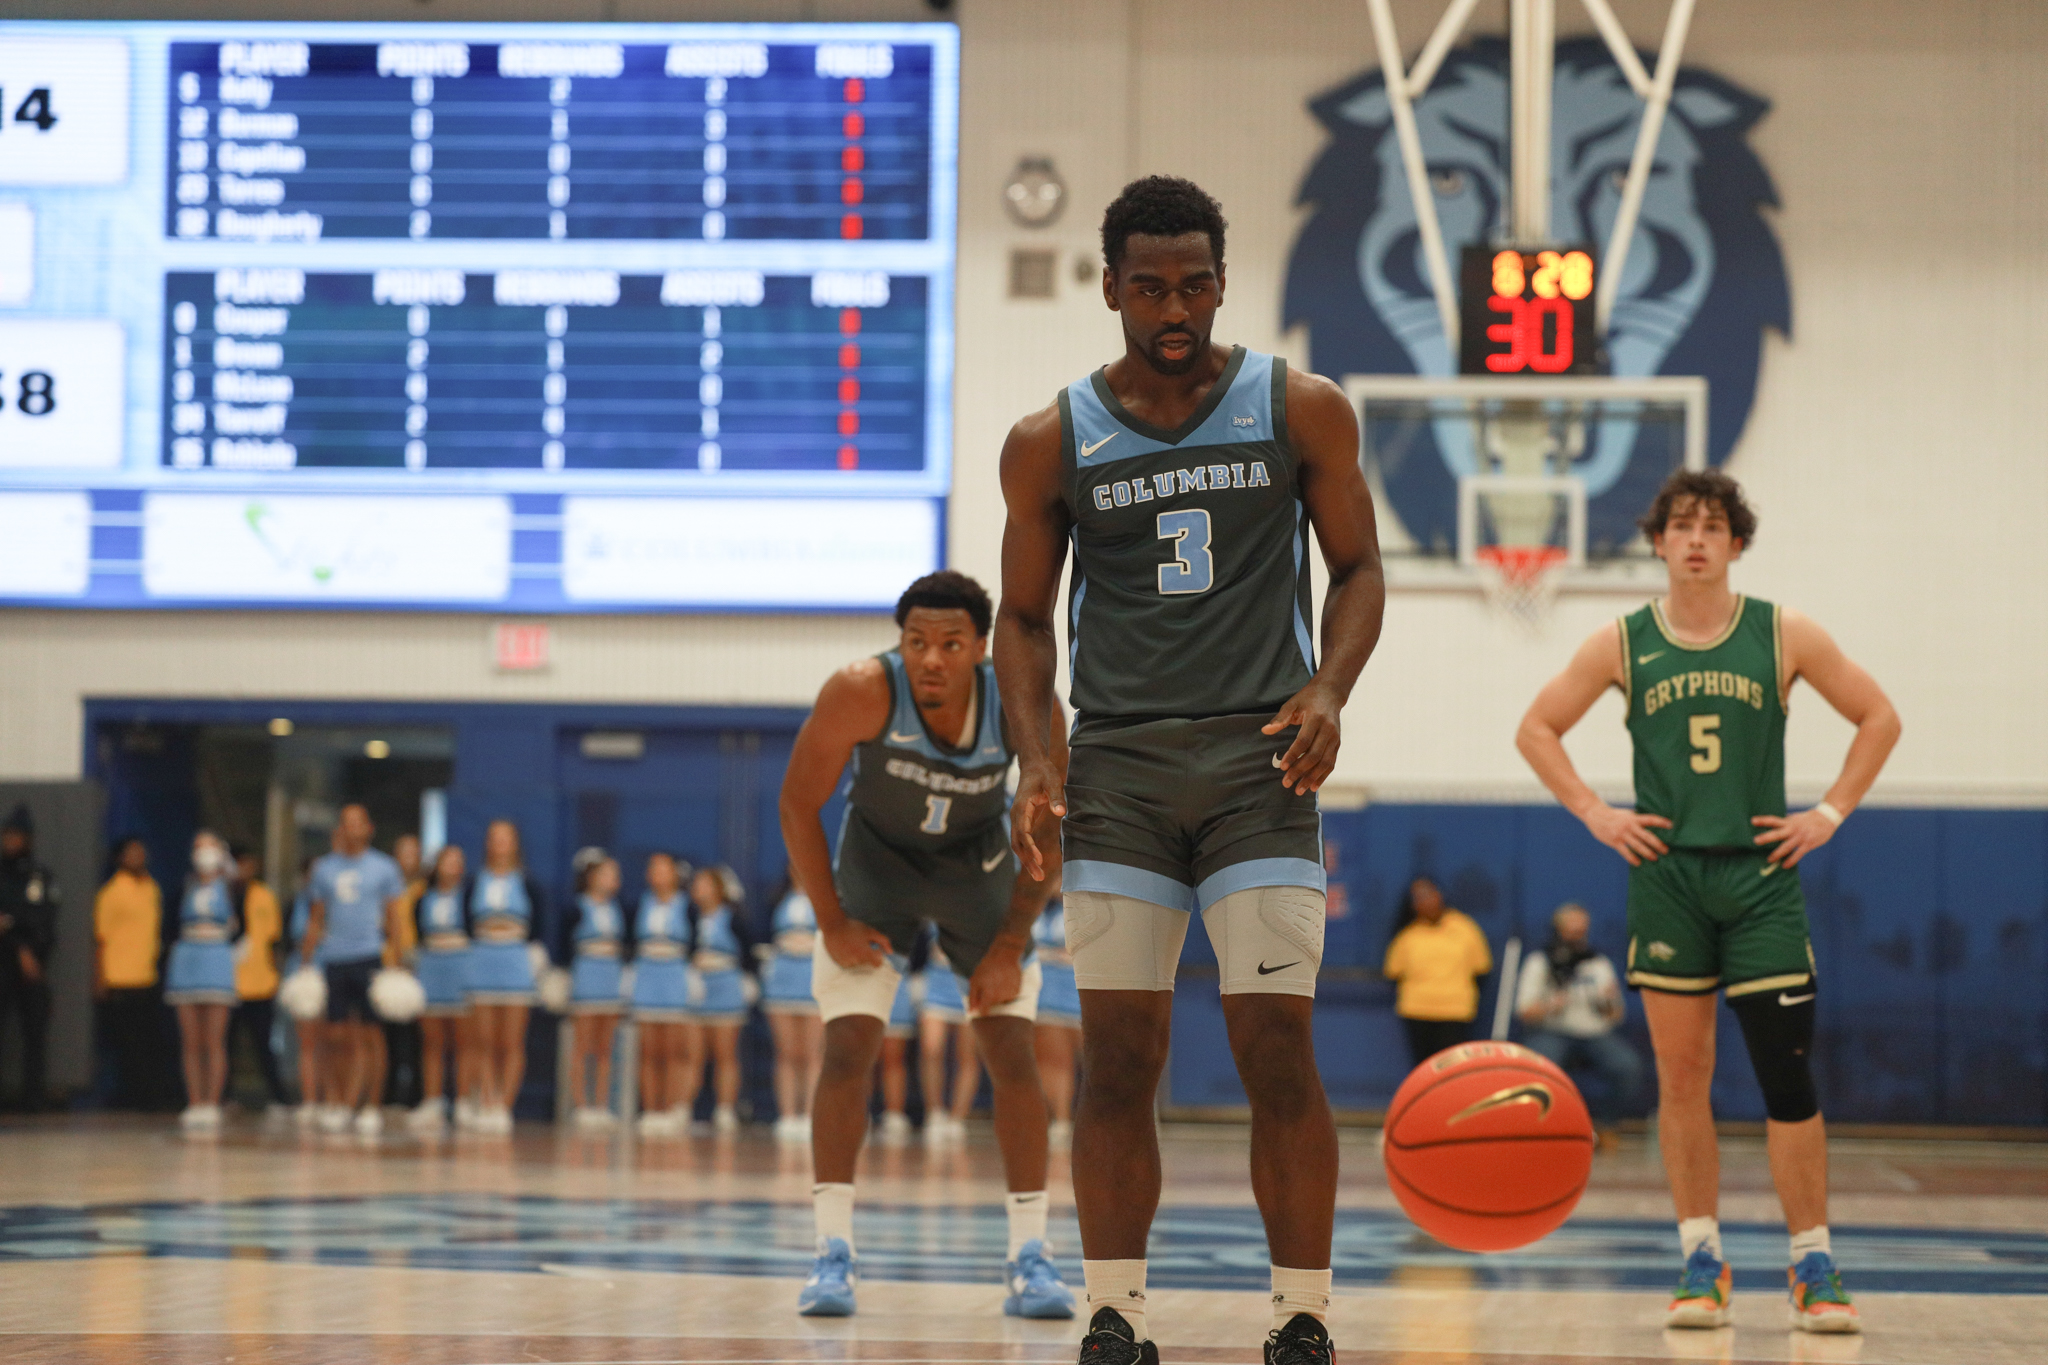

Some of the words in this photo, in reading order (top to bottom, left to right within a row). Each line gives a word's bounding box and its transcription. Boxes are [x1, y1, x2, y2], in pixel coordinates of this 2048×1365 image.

[1485, 295, 1574, 373] 30
[1093, 461, 1271, 511] COLUMBIA
[1157, 508, 1214, 595] 3
[1644, 670, 1763, 716] GRYPHONS
[1689, 713, 1722, 774] 5
[920, 793, 952, 834] 1
